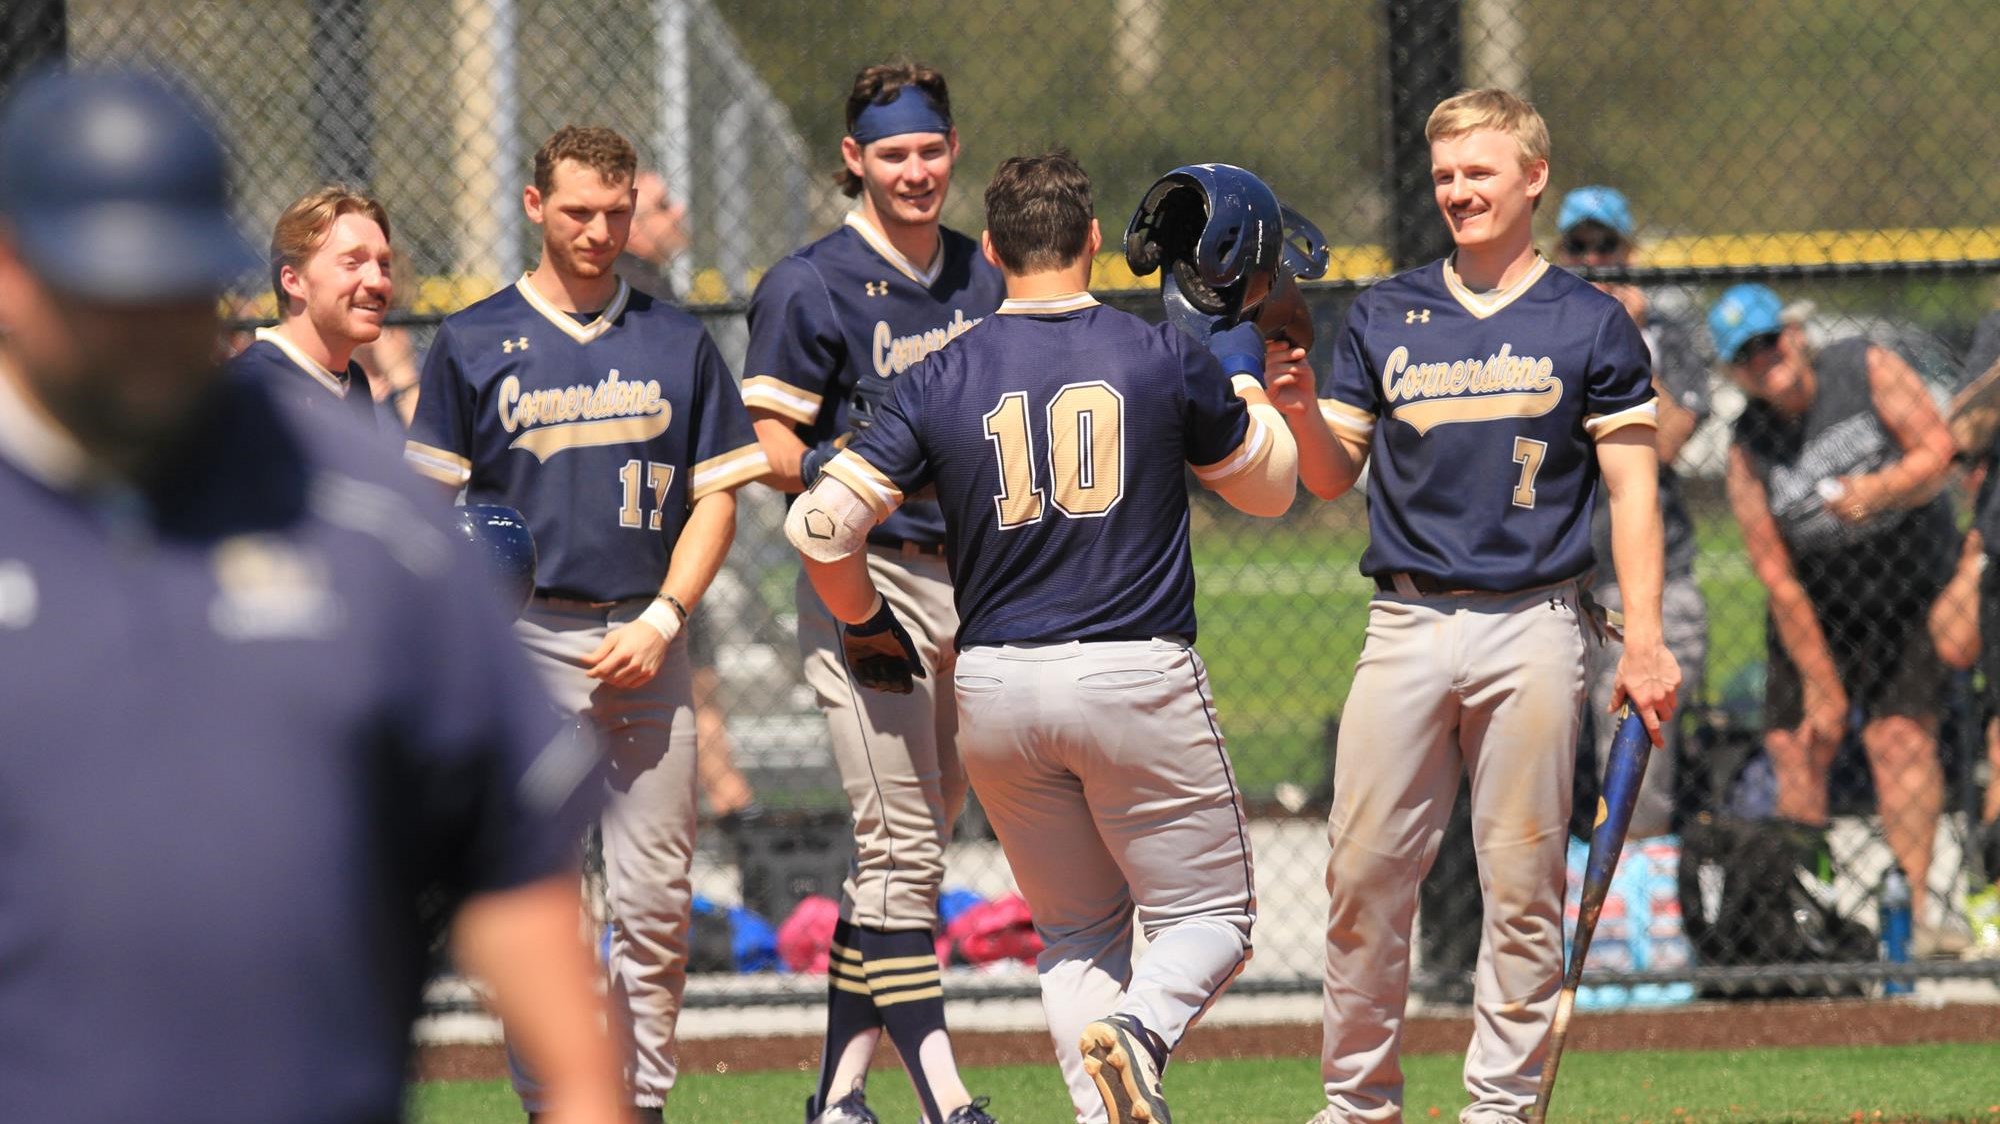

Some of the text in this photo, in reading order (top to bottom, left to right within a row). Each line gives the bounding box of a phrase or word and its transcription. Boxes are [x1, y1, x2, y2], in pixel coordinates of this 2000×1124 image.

[498, 368, 661, 433] Cornerstone
[1383, 342, 1554, 402] Cornerstone
[982, 380, 1125, 531] 10
[1512, 436, 1548, 509] 7
[619, 459, 675, 531] 17
